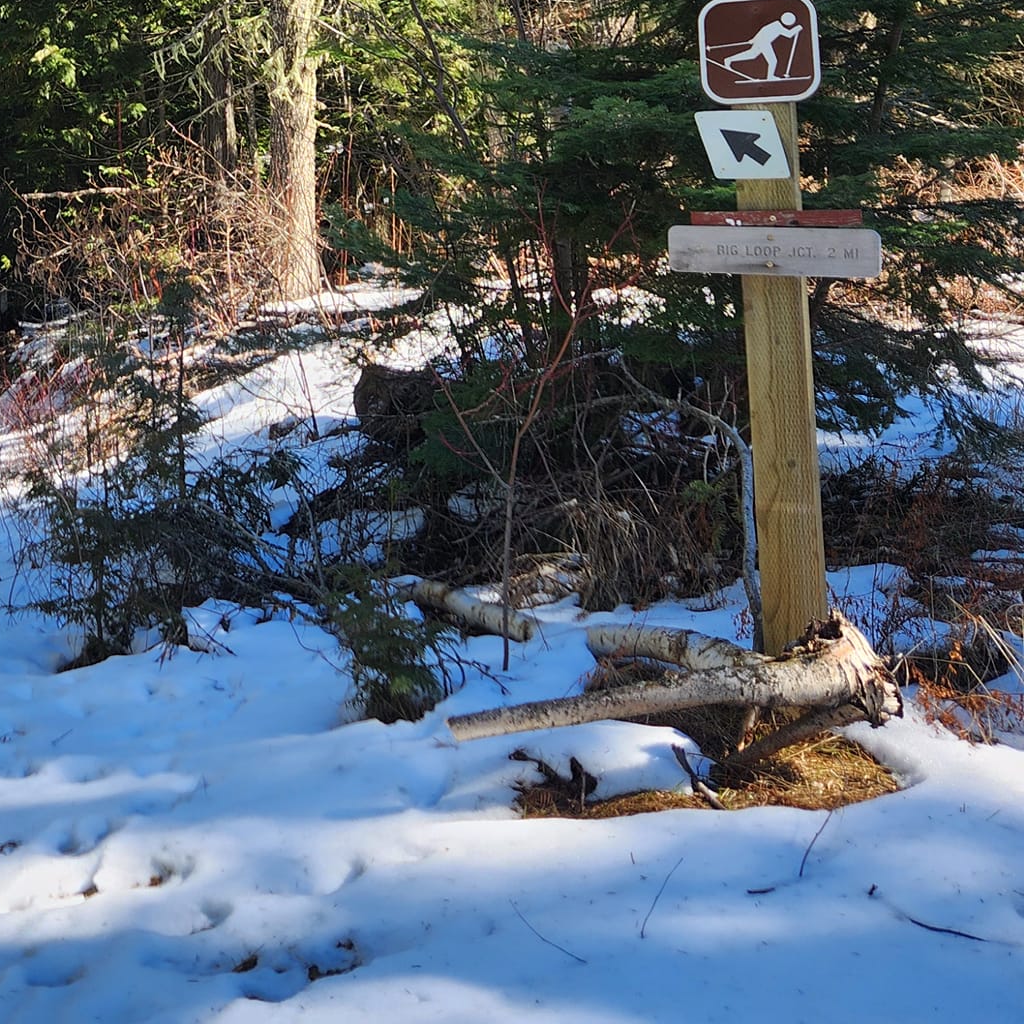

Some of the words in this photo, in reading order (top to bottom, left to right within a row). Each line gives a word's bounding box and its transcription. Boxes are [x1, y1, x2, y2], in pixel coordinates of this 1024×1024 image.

[717, 245, 738, 256] BIG
[745, 246, 781, 257] LOOP
[788, 247, 816, 258] JCT.
[827, 248, 836, 259] 2
[843, 248, 859, 260] MI
